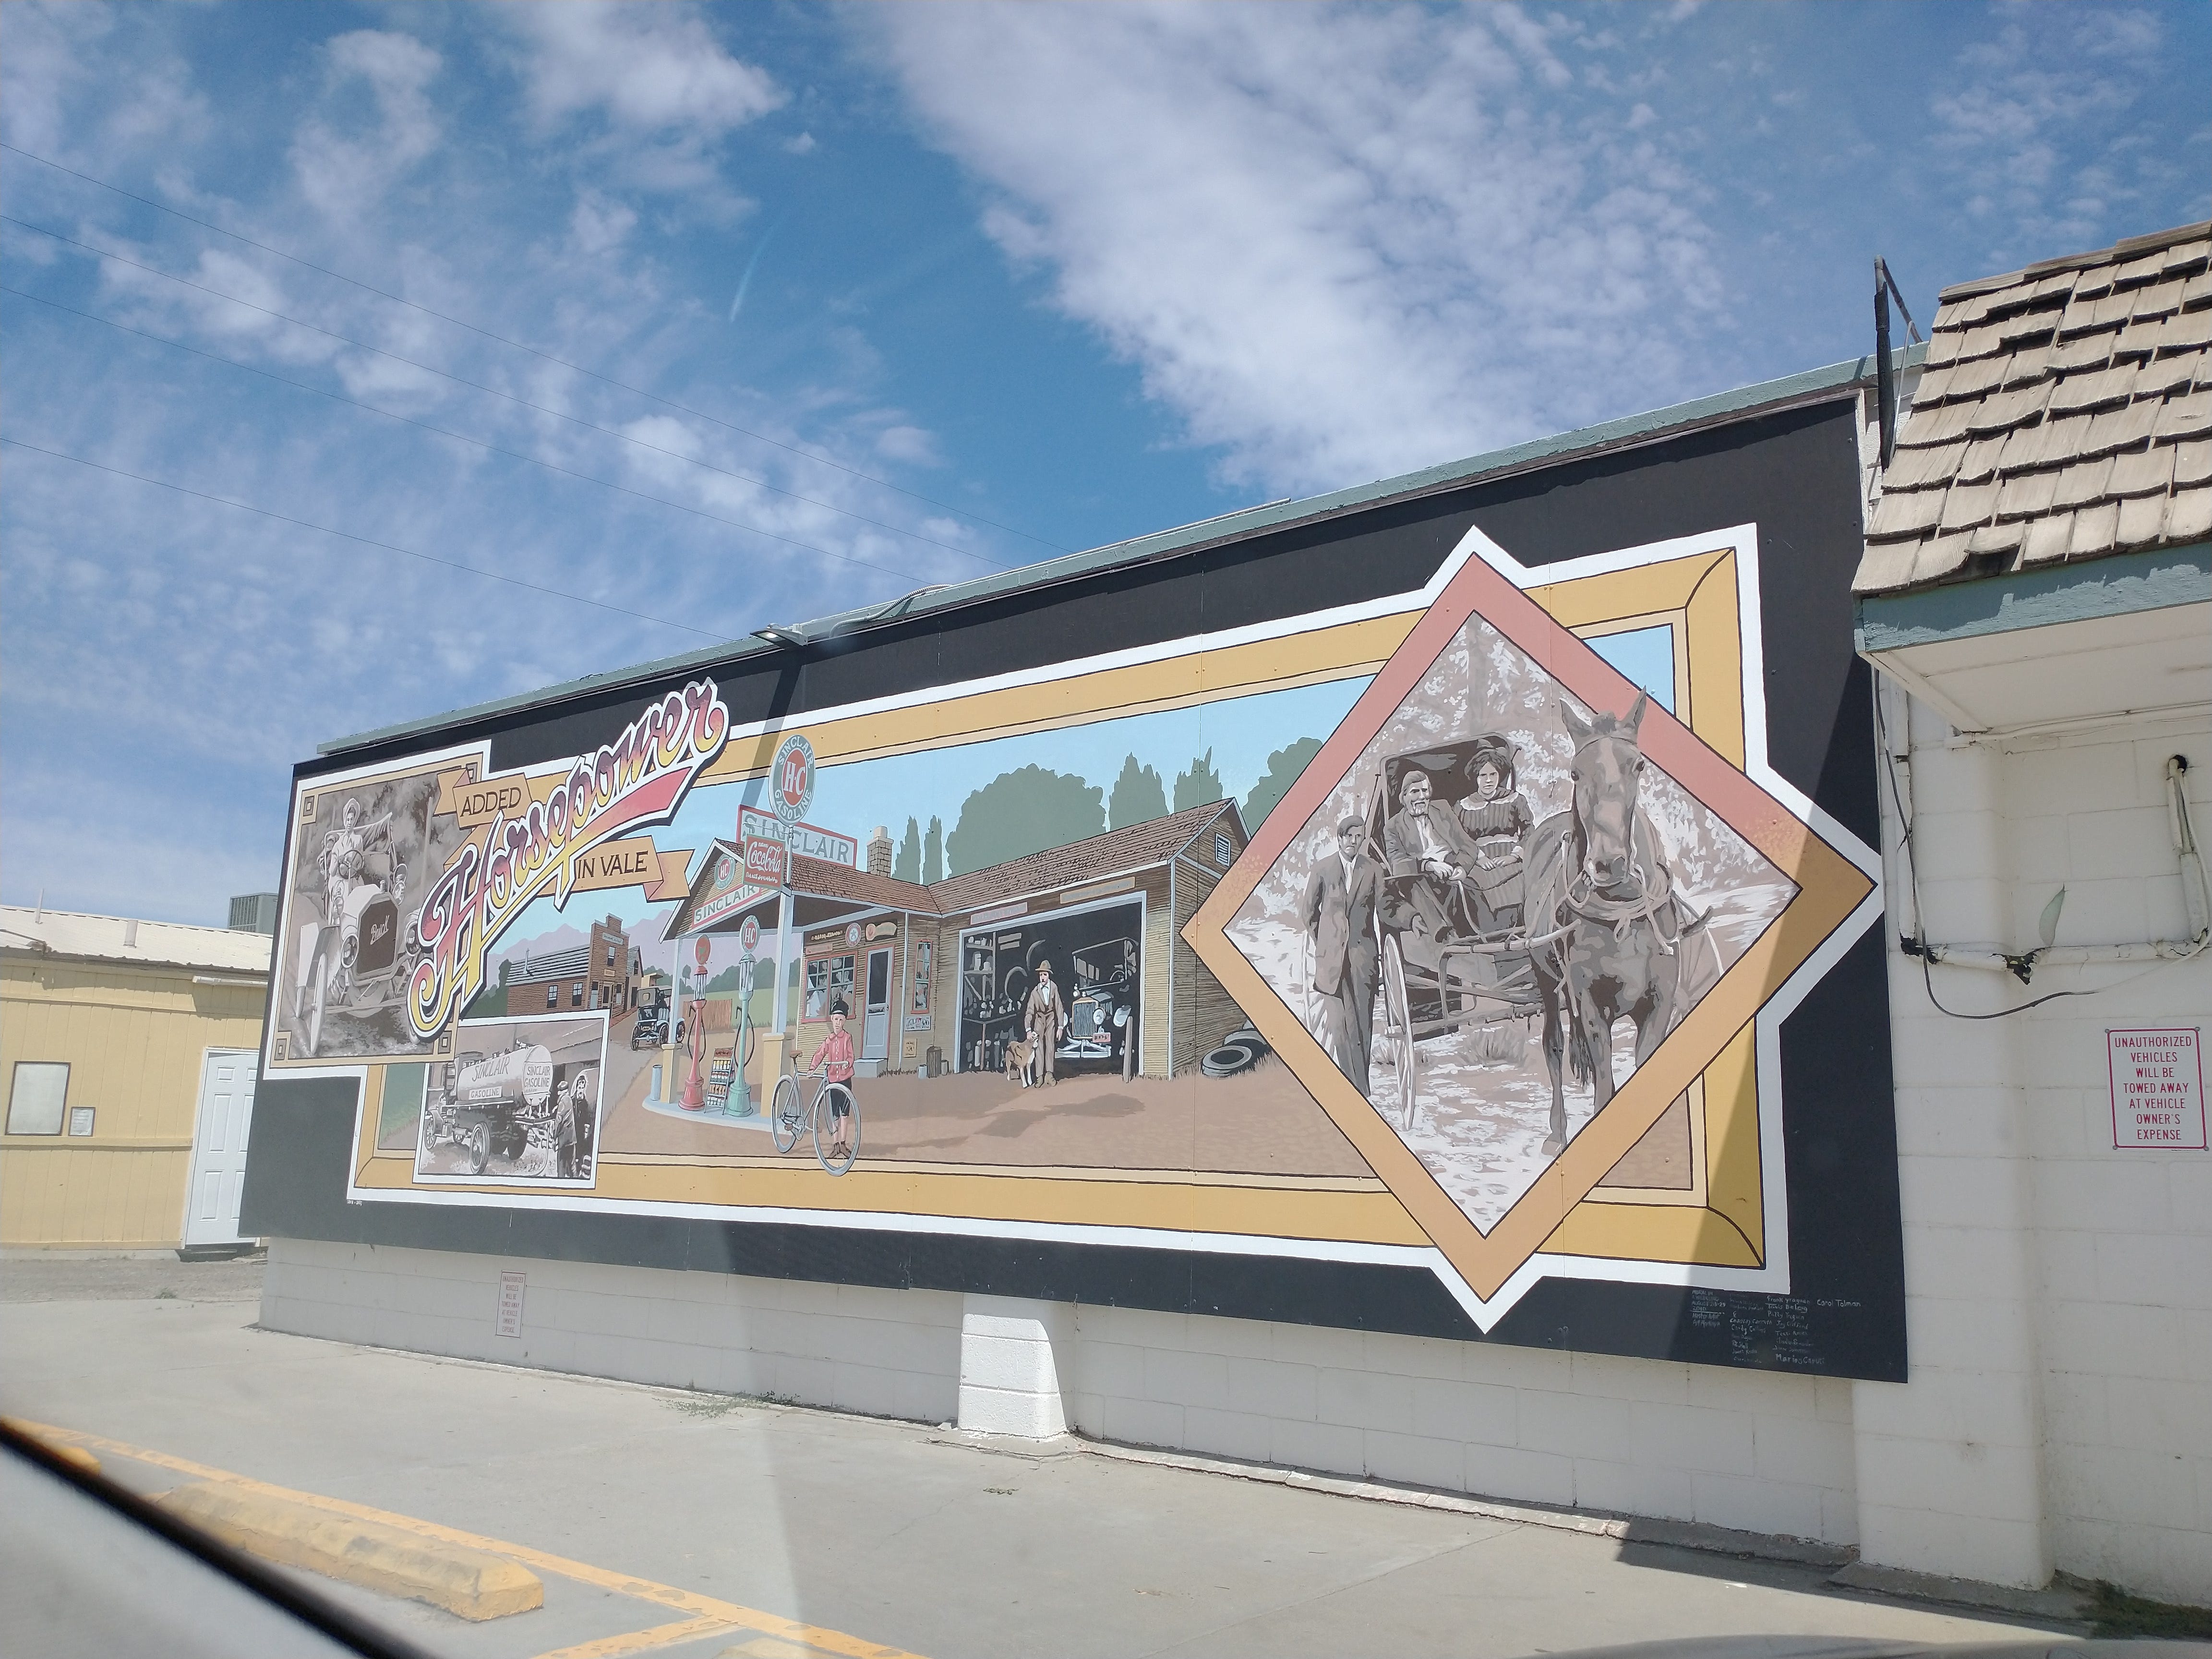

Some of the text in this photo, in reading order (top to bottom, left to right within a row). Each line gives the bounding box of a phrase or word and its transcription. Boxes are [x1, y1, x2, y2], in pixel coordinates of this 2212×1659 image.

[778, 736, 814, 769] SINCLAIR
[460, 787, 522, 817] ADDED
[774, 789, 812, 820] GASOLINE
[743, 814, 848, 863] SINCLAIR
[409, 682, 726, 1036] Horsepower
[577, 850, 649, 879] IN VALE
[696, 885, 756, 922] SINCLAIR
[2115, 1036, 2192, 1048] UNAUTHORIZED
[2130, 1052, 2178, 1063] VEHICLES
[472, 1056, 510, 1082] SINCLAIR
[527, 1066, 551, 1076] SINCLAIR
[2136, 1067, 2175, 1078] WILL BE
[524, 1077, 550, 1087] GASOLINE
[2124, 1082, 2189, 1094] TOWED AWAY
[471, 1088, 500, 1098] GASOLINE
[2129, 1098, 2187, 1109] AT VEHICLE
[2136, 1114, 2181, 1124] OWNER'S
[2137, 1129, 2182, 1140] EXPENSE
